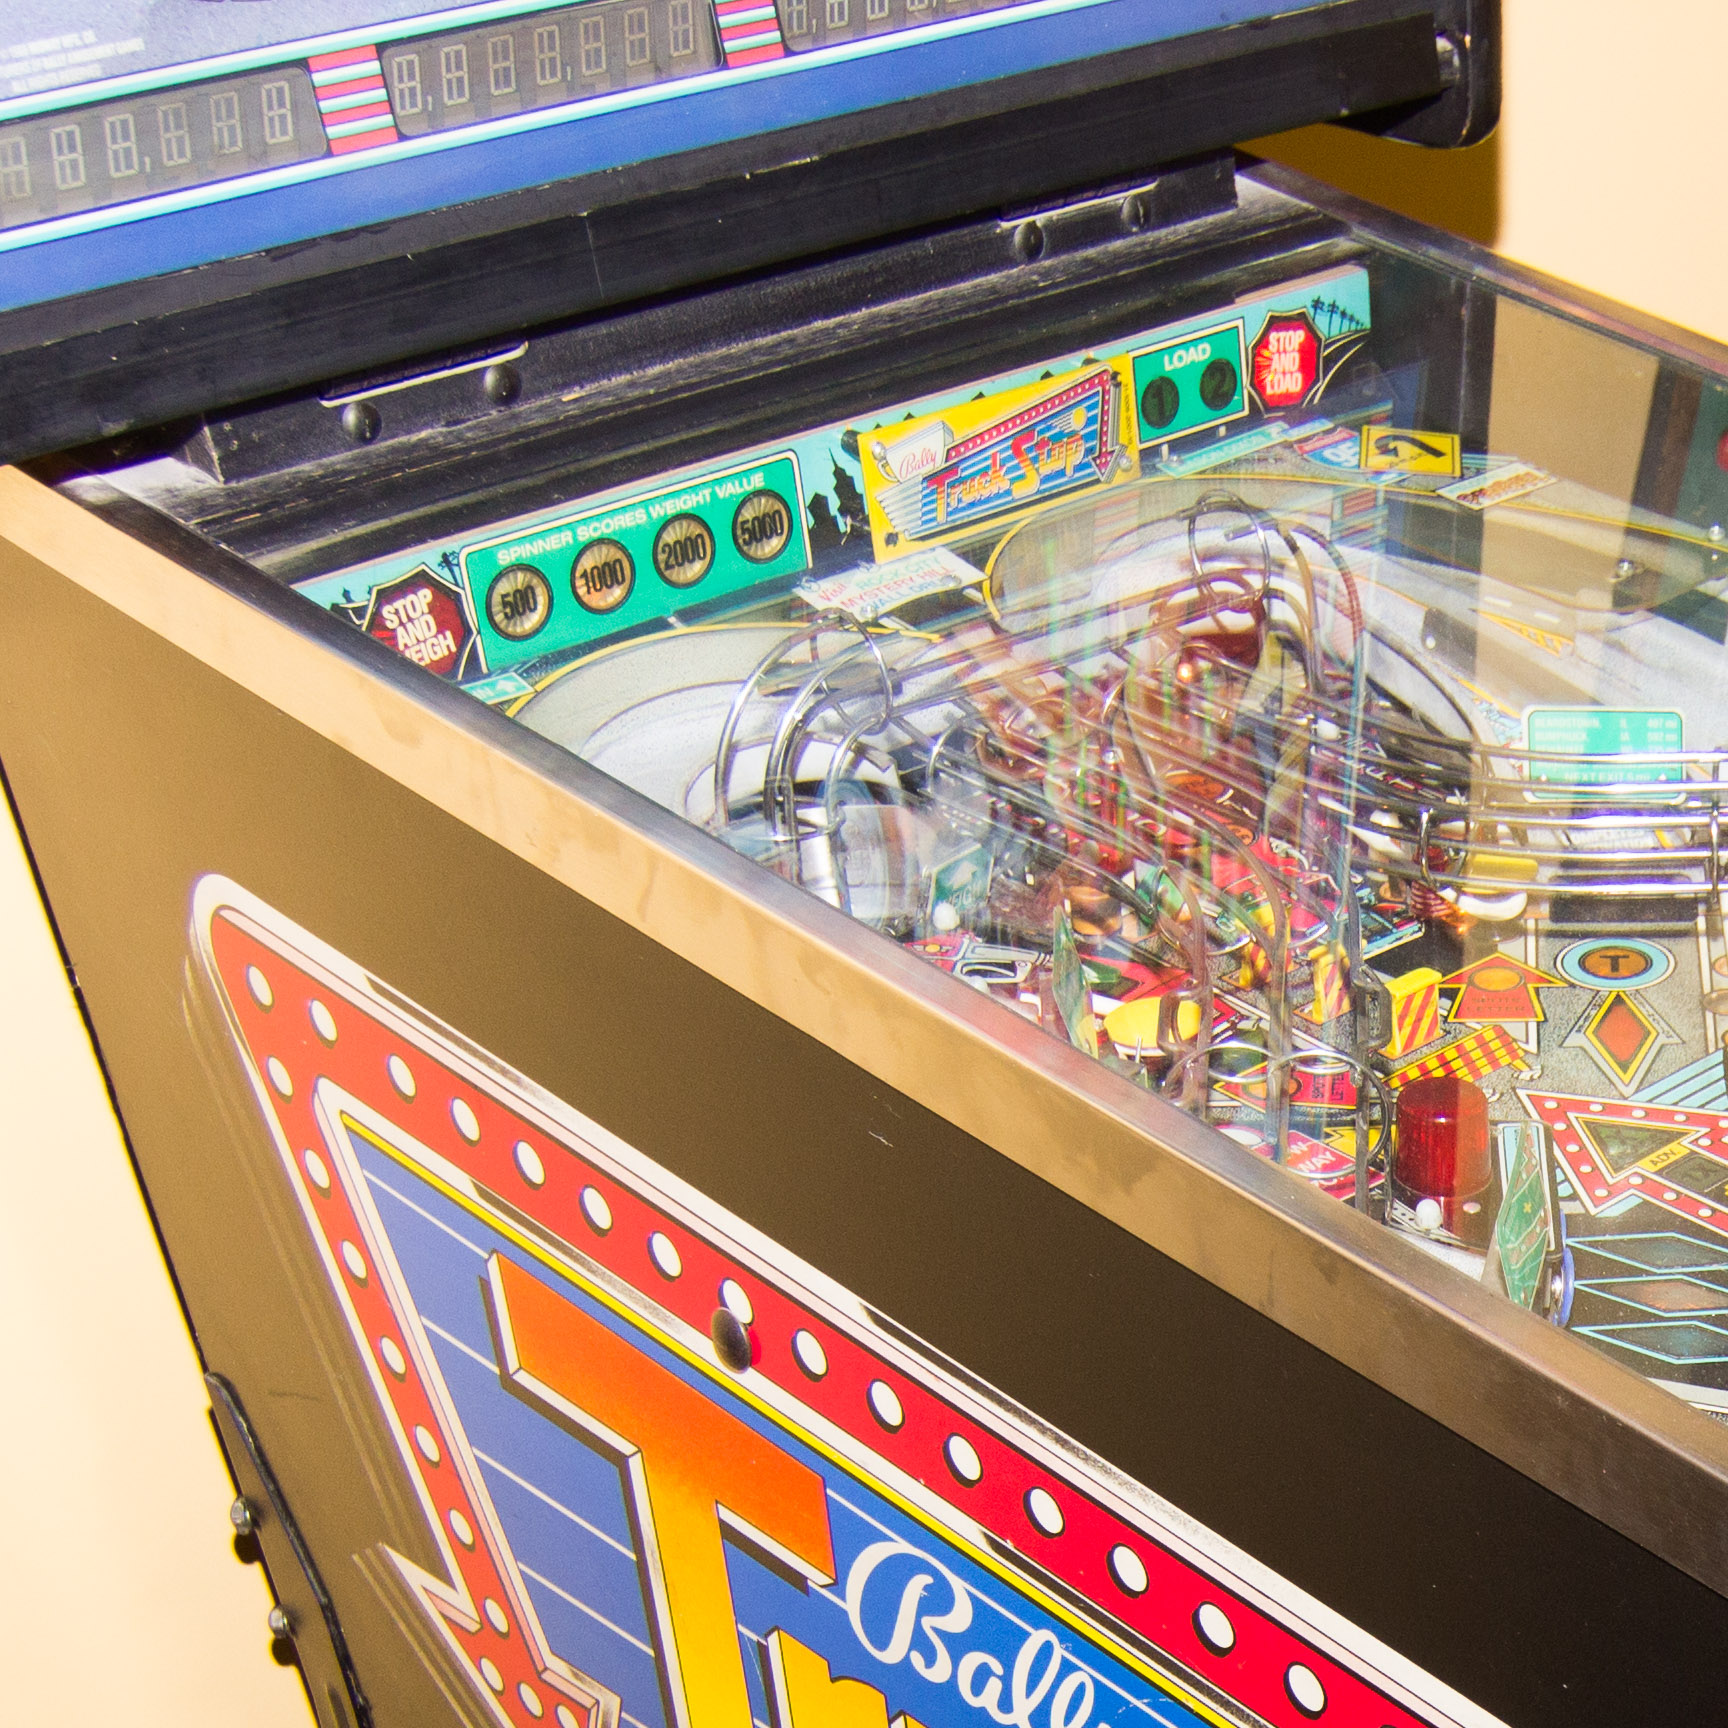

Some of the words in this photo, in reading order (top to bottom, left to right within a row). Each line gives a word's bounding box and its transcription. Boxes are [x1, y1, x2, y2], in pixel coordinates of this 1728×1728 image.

[1163, 342, 1211, 371] LOAD
[1269, 329, 1304, 353] STOP
[1271, 353, 1299, 373] AND
[1266, 371, 1302, 395] LOAD
[900, 447, 938, 480] Bally
[927, 451, 1010, 523] Truck
[1010, 428, 1085, 500] Stop
[496, 529, 574, 566] SPINNER
[576, 507, 647, 541] SCORES
[648, 487, 713, 520] WEIGHT
[714, 471, 766, 500] VALUE
[500, 584, 539, 621] 500
[579, 558, 625, 596] 1000
[661, 533, 705, 571] 2000
[741, 508, 785, 547] 5000
[381, 588, 433, 629] STOP
[396, 614, 437, 650] AND
[1600, 955, 1630, 972] T
[1649, 1147, 1682, 1167] ADV.
